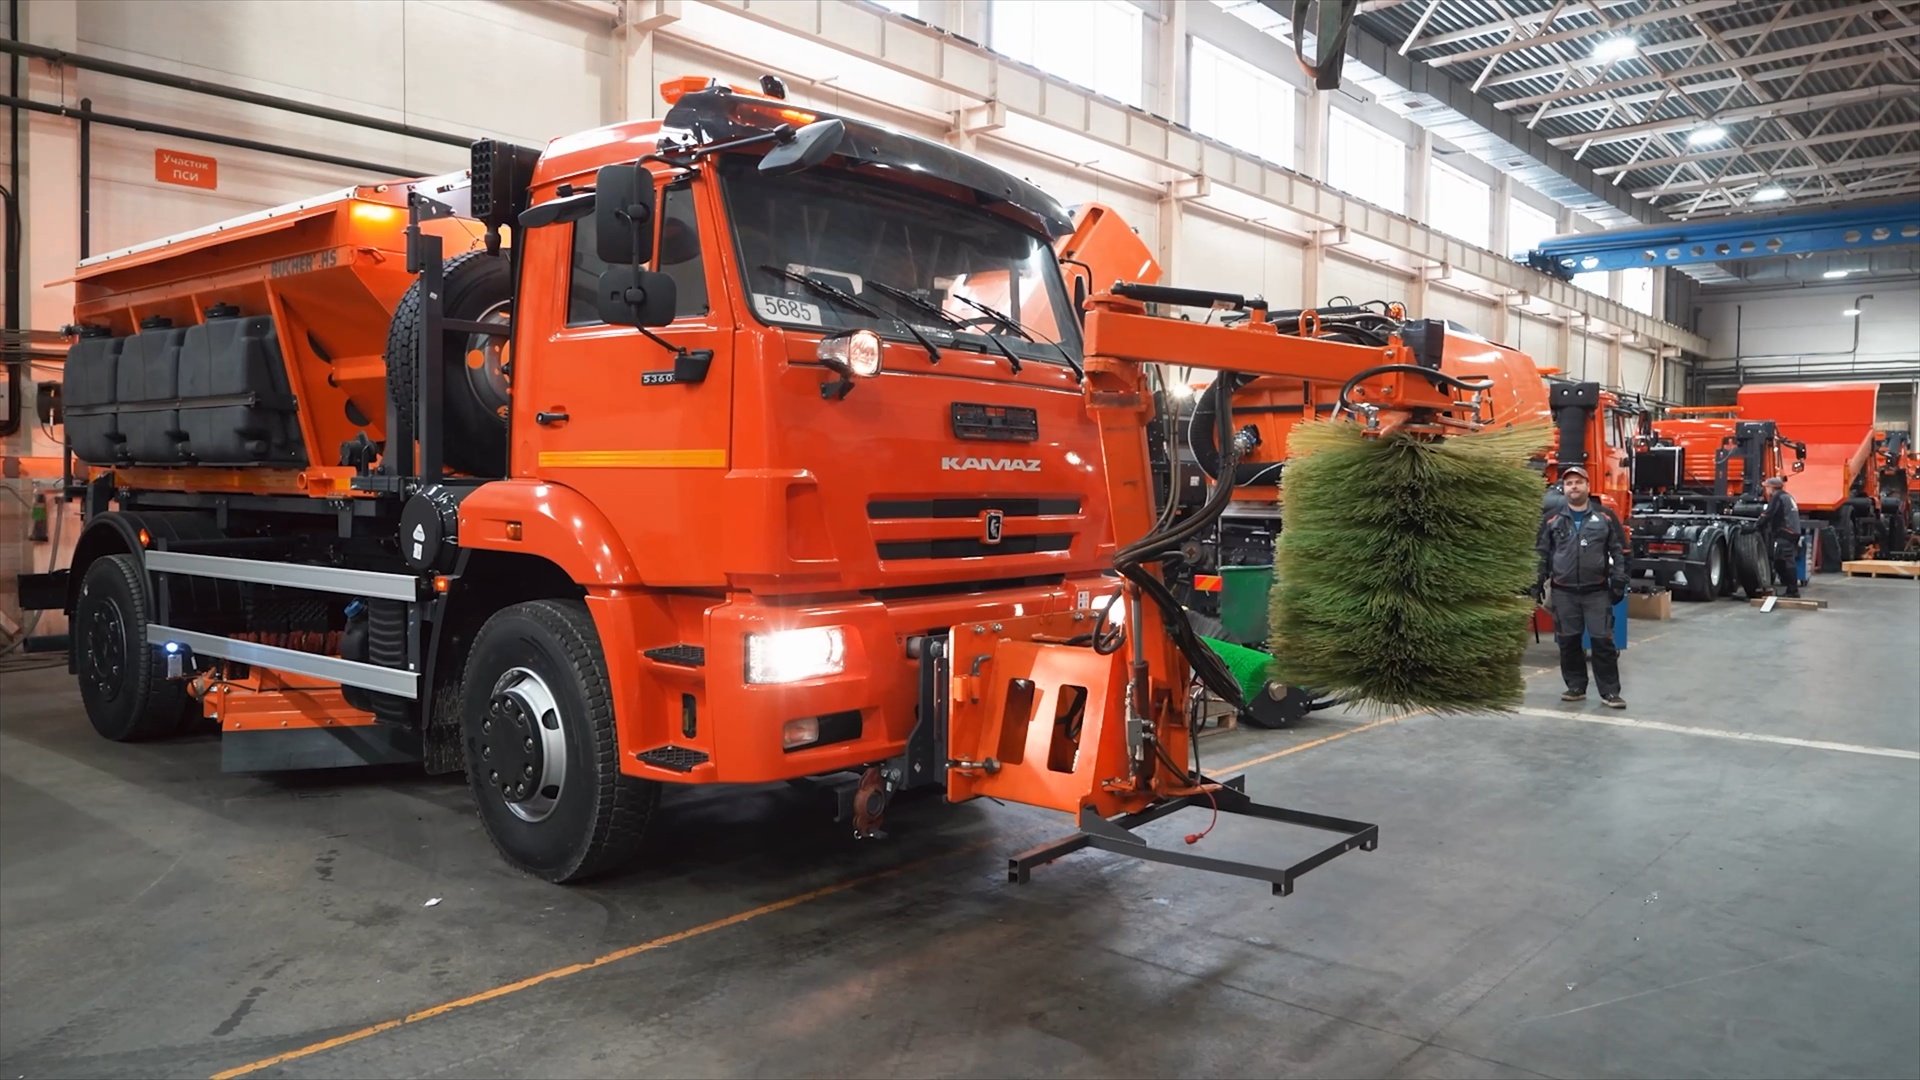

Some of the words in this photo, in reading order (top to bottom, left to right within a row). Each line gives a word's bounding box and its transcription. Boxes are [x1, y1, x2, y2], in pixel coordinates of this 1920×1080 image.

[163, 154, 209, 170] Участок
[173, 169, 199, 182] ПСИ
[271, 254, 314, 278] BUCHER
[321, 249, 337, 268] HS
[764, 296, 812, 321] 5685
[642, 374, 675, 384] 5360
[941, 457, 1041, 471] KAMAZ
